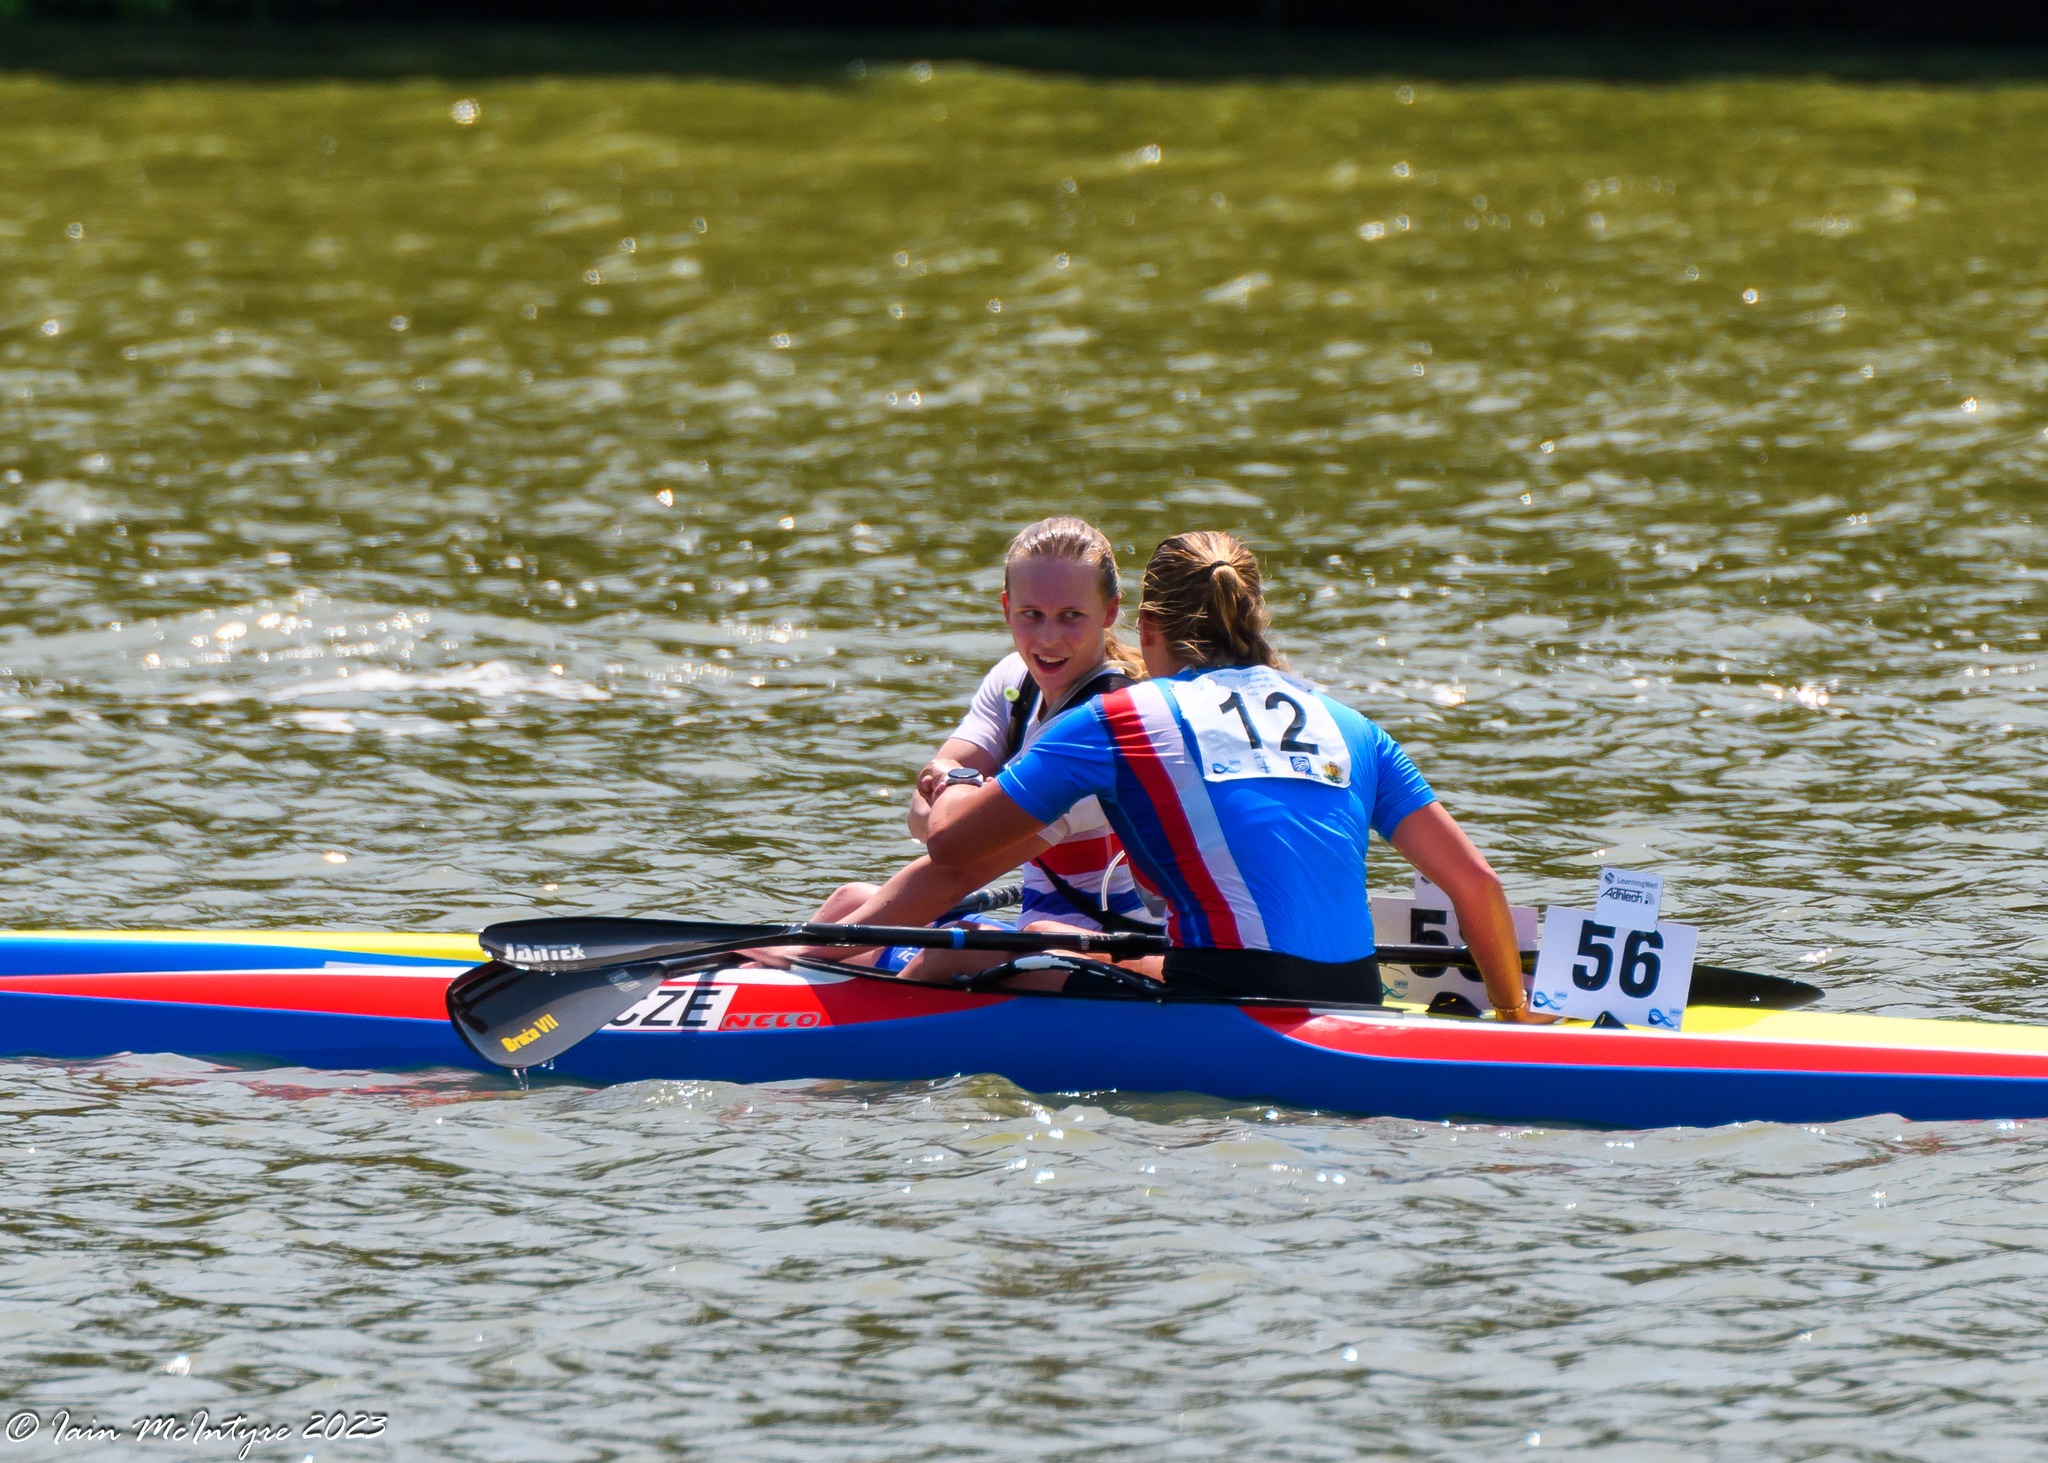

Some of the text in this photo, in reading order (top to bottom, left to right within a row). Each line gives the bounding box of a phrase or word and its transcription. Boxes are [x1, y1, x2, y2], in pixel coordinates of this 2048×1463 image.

[1219, 691, 1319, 755] 12
[1572, 919, 1664, 998] 56
[533, 1013, 559, 1033] VII
[723, 1013, 818, 1029] NELO
